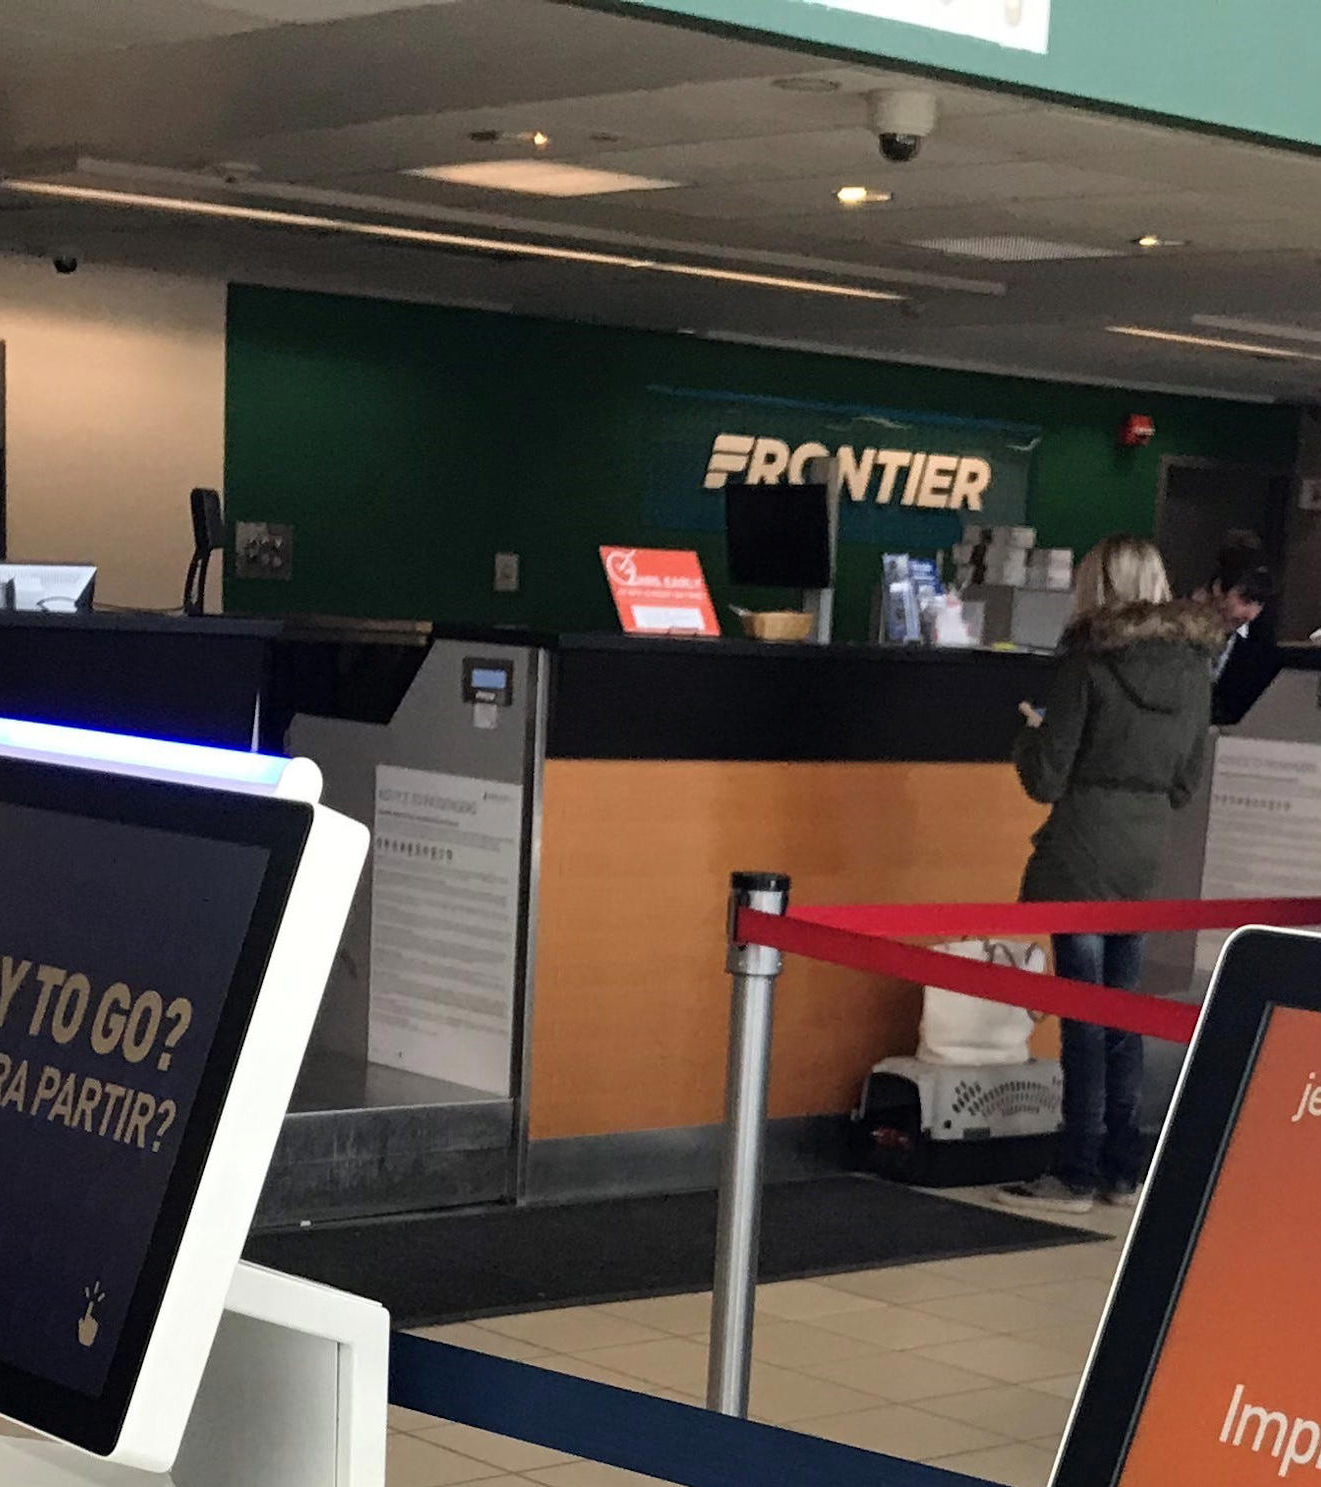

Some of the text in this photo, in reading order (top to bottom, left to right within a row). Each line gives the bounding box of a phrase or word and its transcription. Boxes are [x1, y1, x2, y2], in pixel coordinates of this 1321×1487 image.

[29, 963, 91, 1044] TO
[91, 982, 193, 1071] GO?
[30, 1065, 177, 1153] PARTIR?
